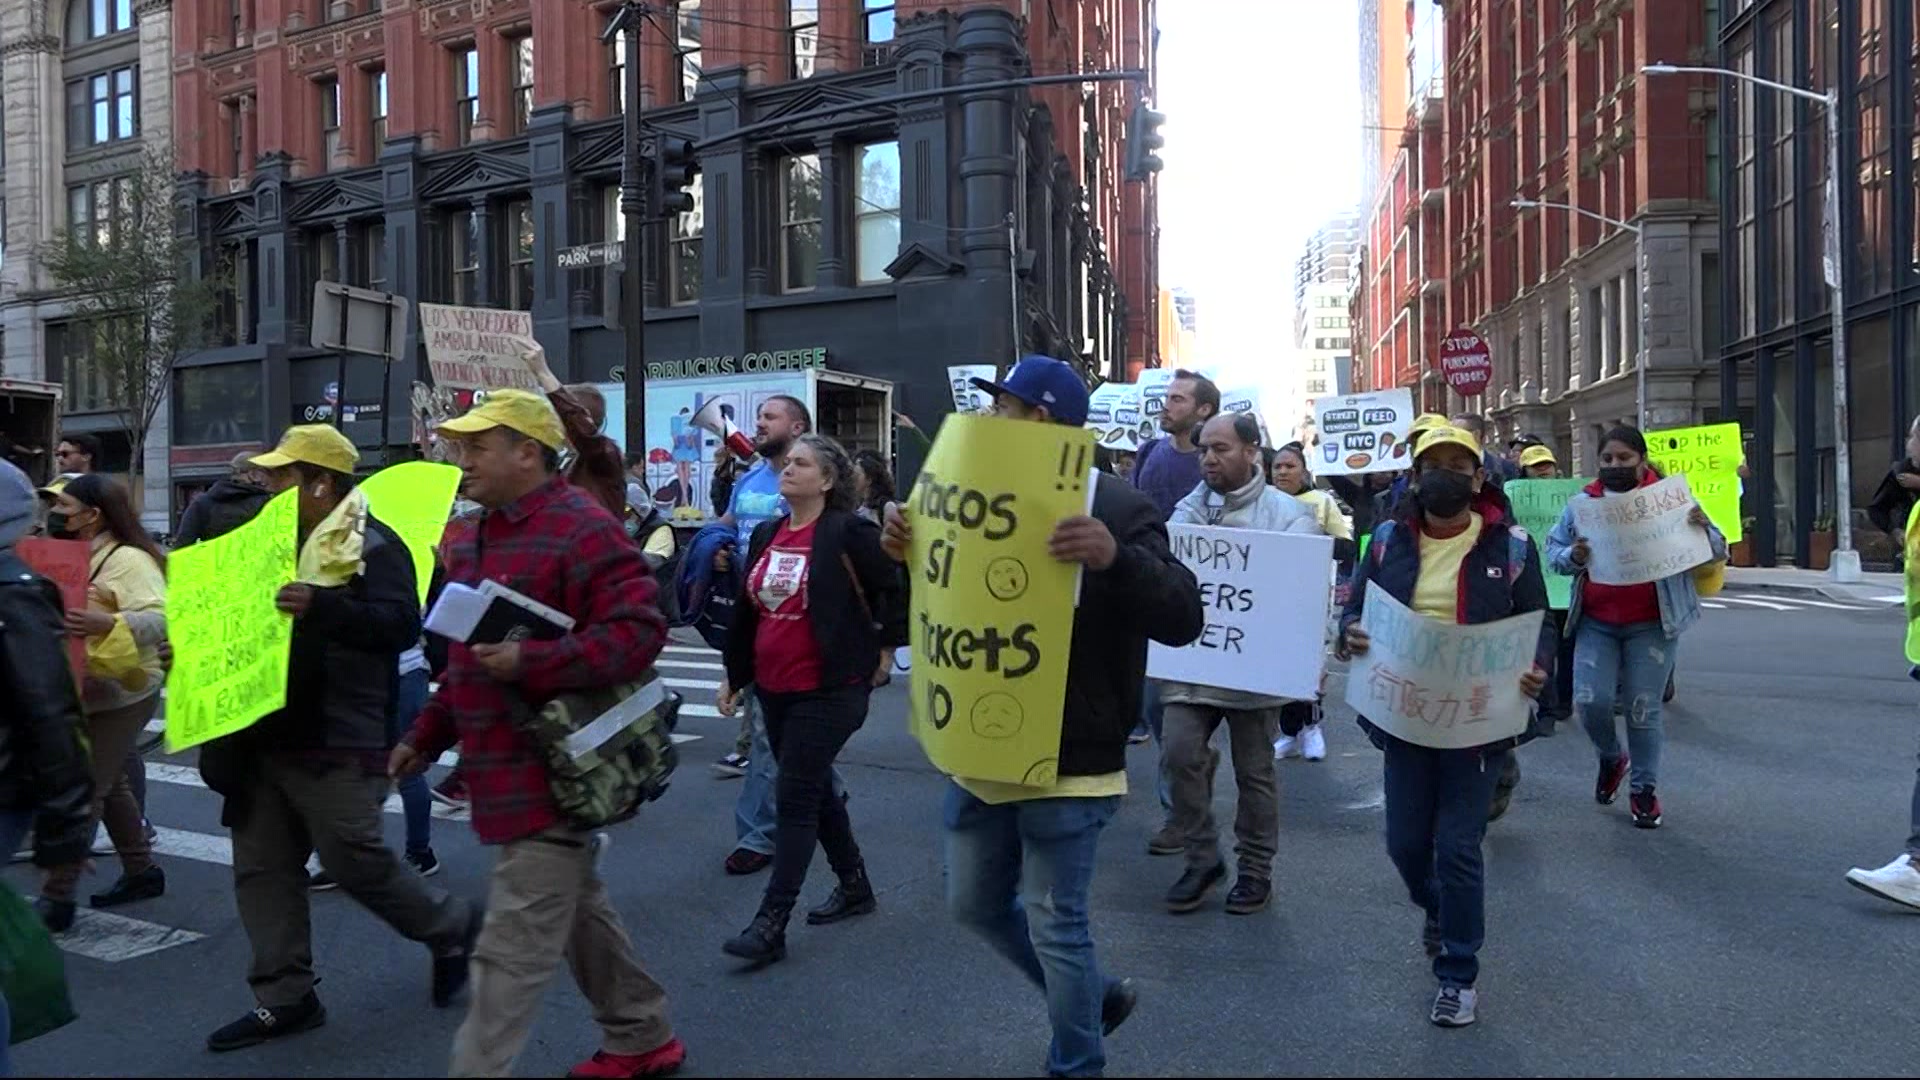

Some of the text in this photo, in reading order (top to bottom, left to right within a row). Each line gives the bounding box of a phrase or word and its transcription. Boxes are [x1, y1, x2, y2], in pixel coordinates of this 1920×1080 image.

[558, 252, 589, 267] PARK
[423, 307, 530, 337] LOS VENDEDORES
[1446, 336, 1479, 351] STOP
[609, 347, 827, 383] SRBUCKS COFFEE
[1442, 353, 1490, 369] PUNISHING
[1447, 370, 1488, 385] VENDORS
[1324, 411, 1357, 420] STREET
[1365, 411, 1394, 422] FEED
[1347, 435, 1373, 448] NYC
[1696, 433, 1722, 447] the
